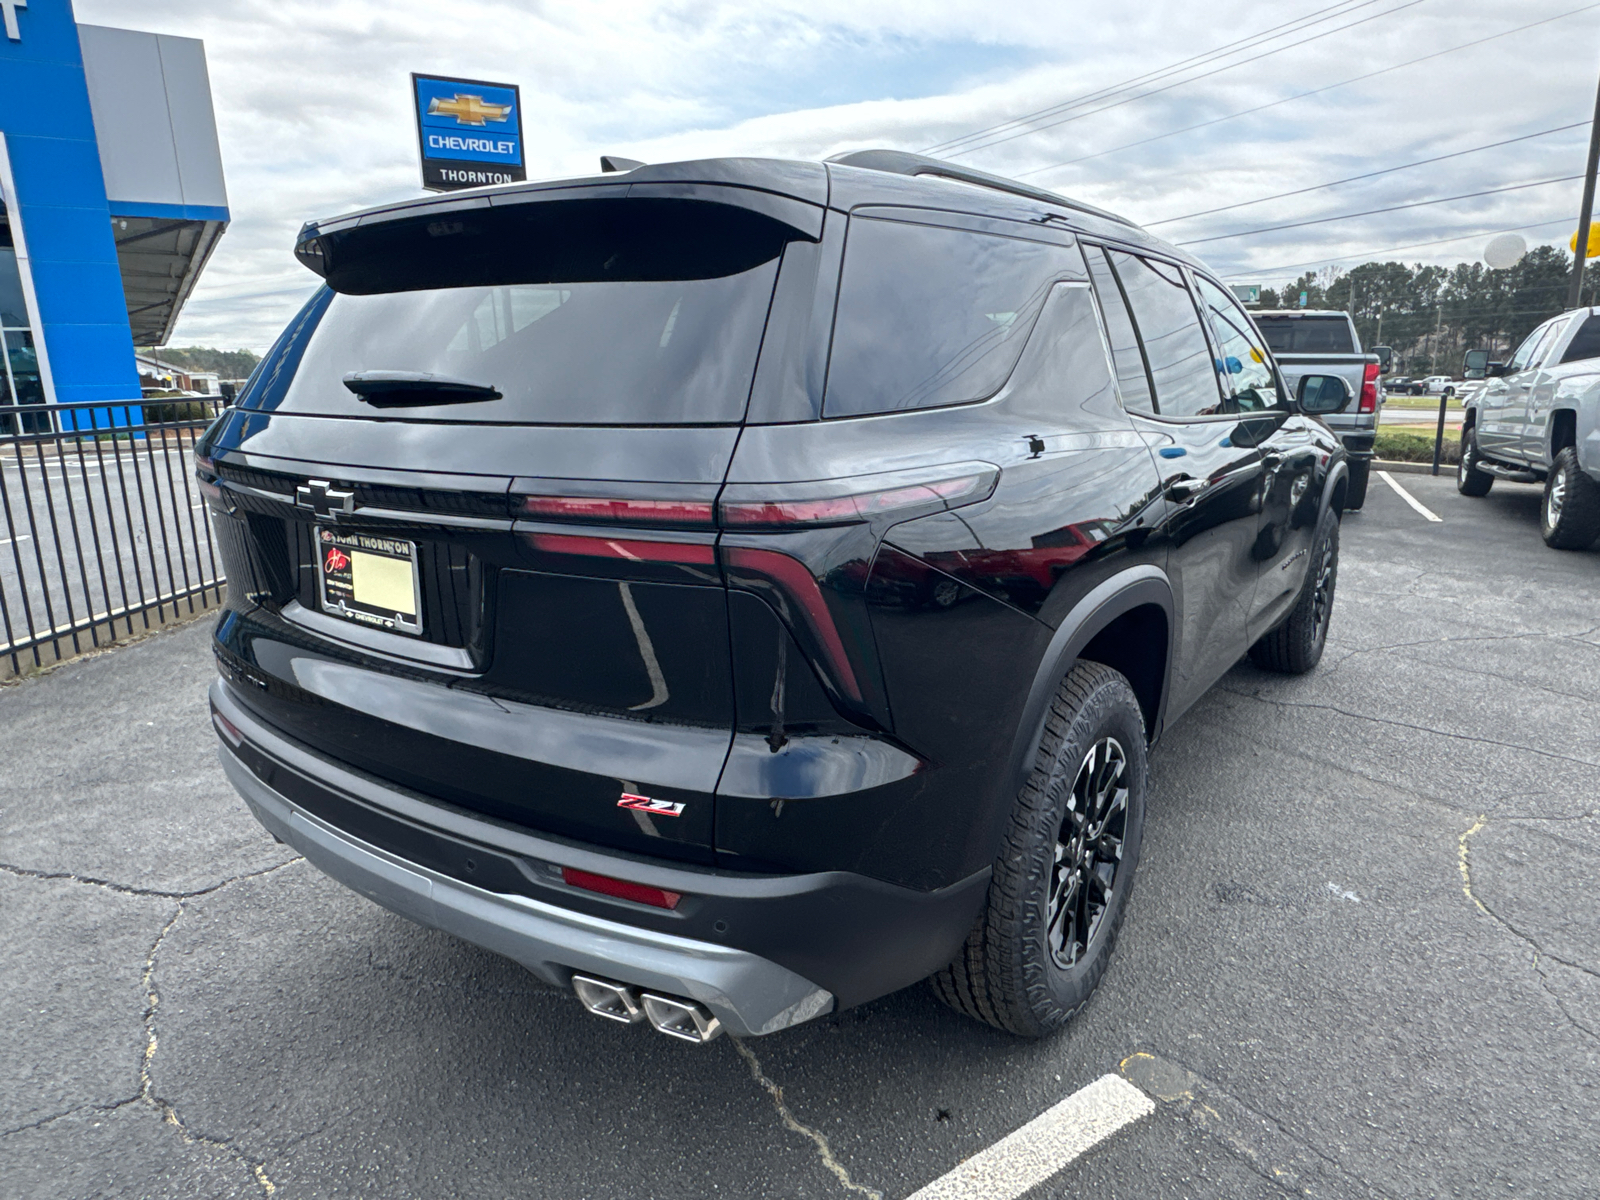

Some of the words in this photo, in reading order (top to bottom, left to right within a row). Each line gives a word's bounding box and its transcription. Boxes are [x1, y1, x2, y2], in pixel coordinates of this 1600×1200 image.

[429, 135, 515, 154] CHEVROLET
[440, 169, 512, 184] THORNTON
[617, 792, 687, 818] Z71
